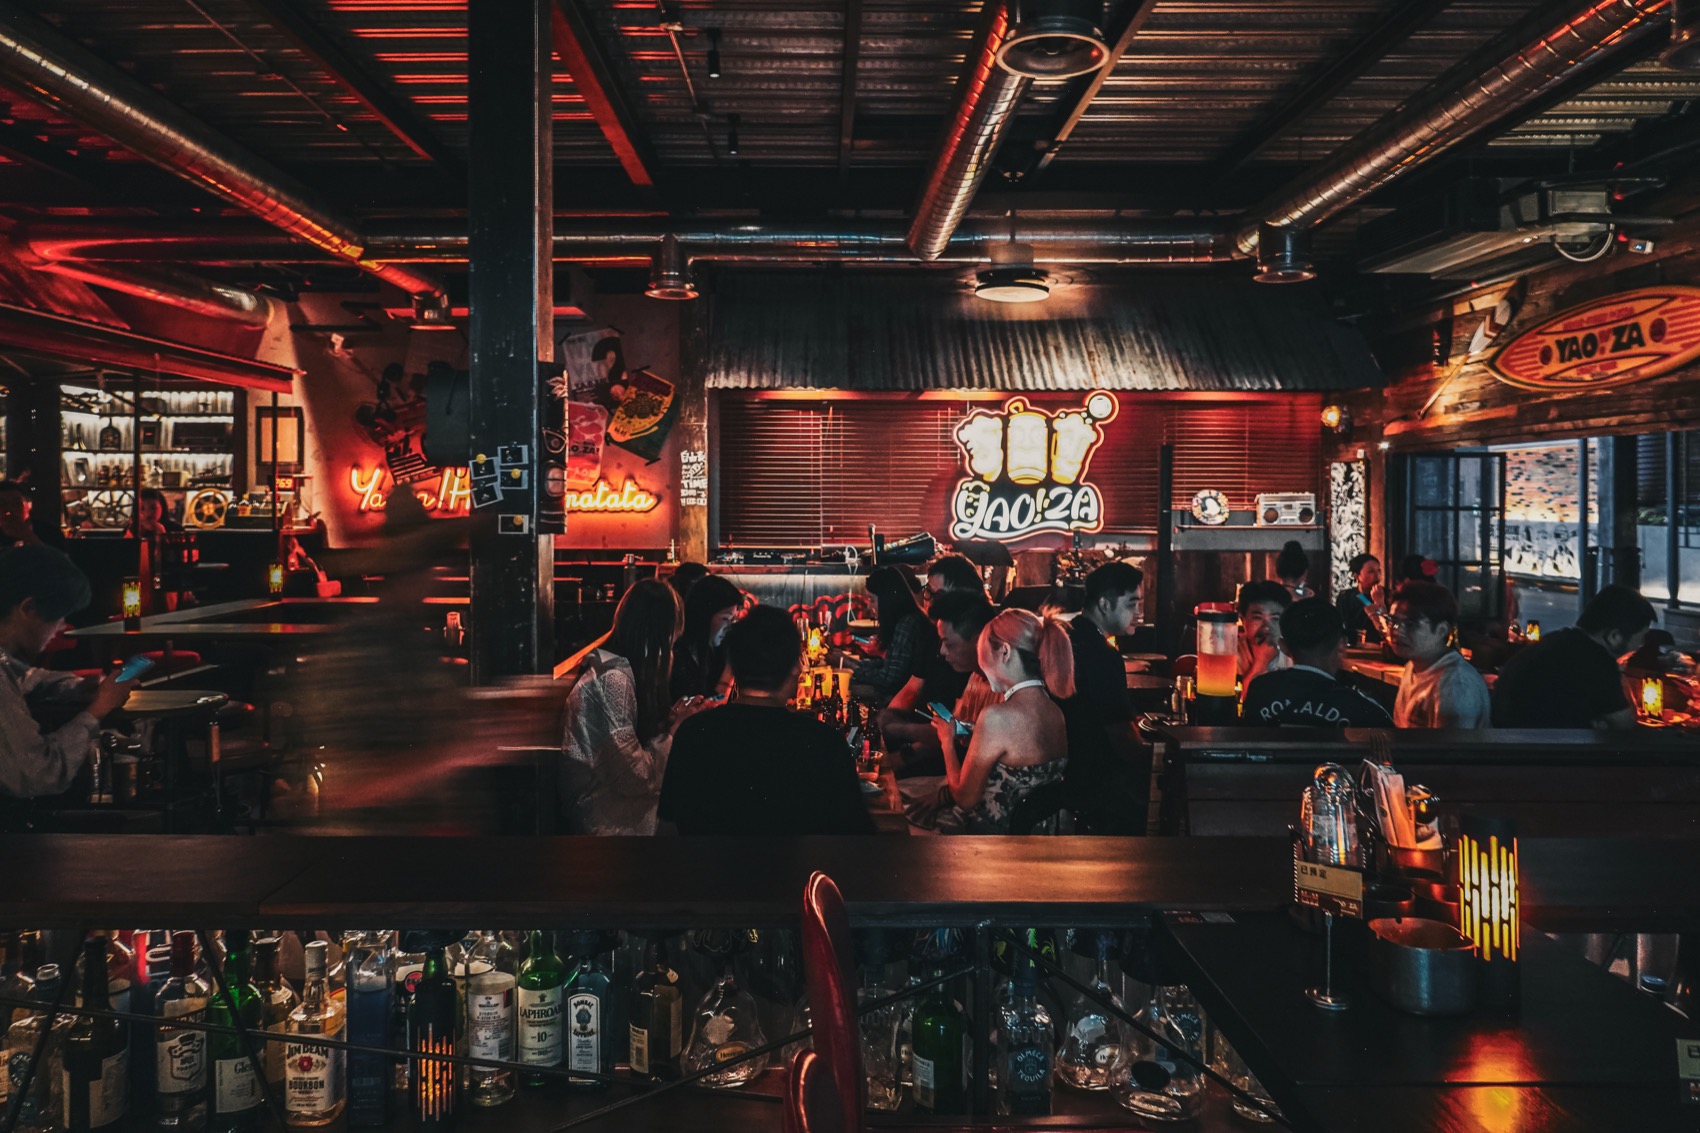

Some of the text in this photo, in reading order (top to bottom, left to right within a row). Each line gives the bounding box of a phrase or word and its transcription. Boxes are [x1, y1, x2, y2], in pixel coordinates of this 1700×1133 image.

[537, 1032, 547, 1043] 10
[1016, 1069, 1046, 1083] TEQUILA
[289, 1080, 325, 1090] BOURBON
